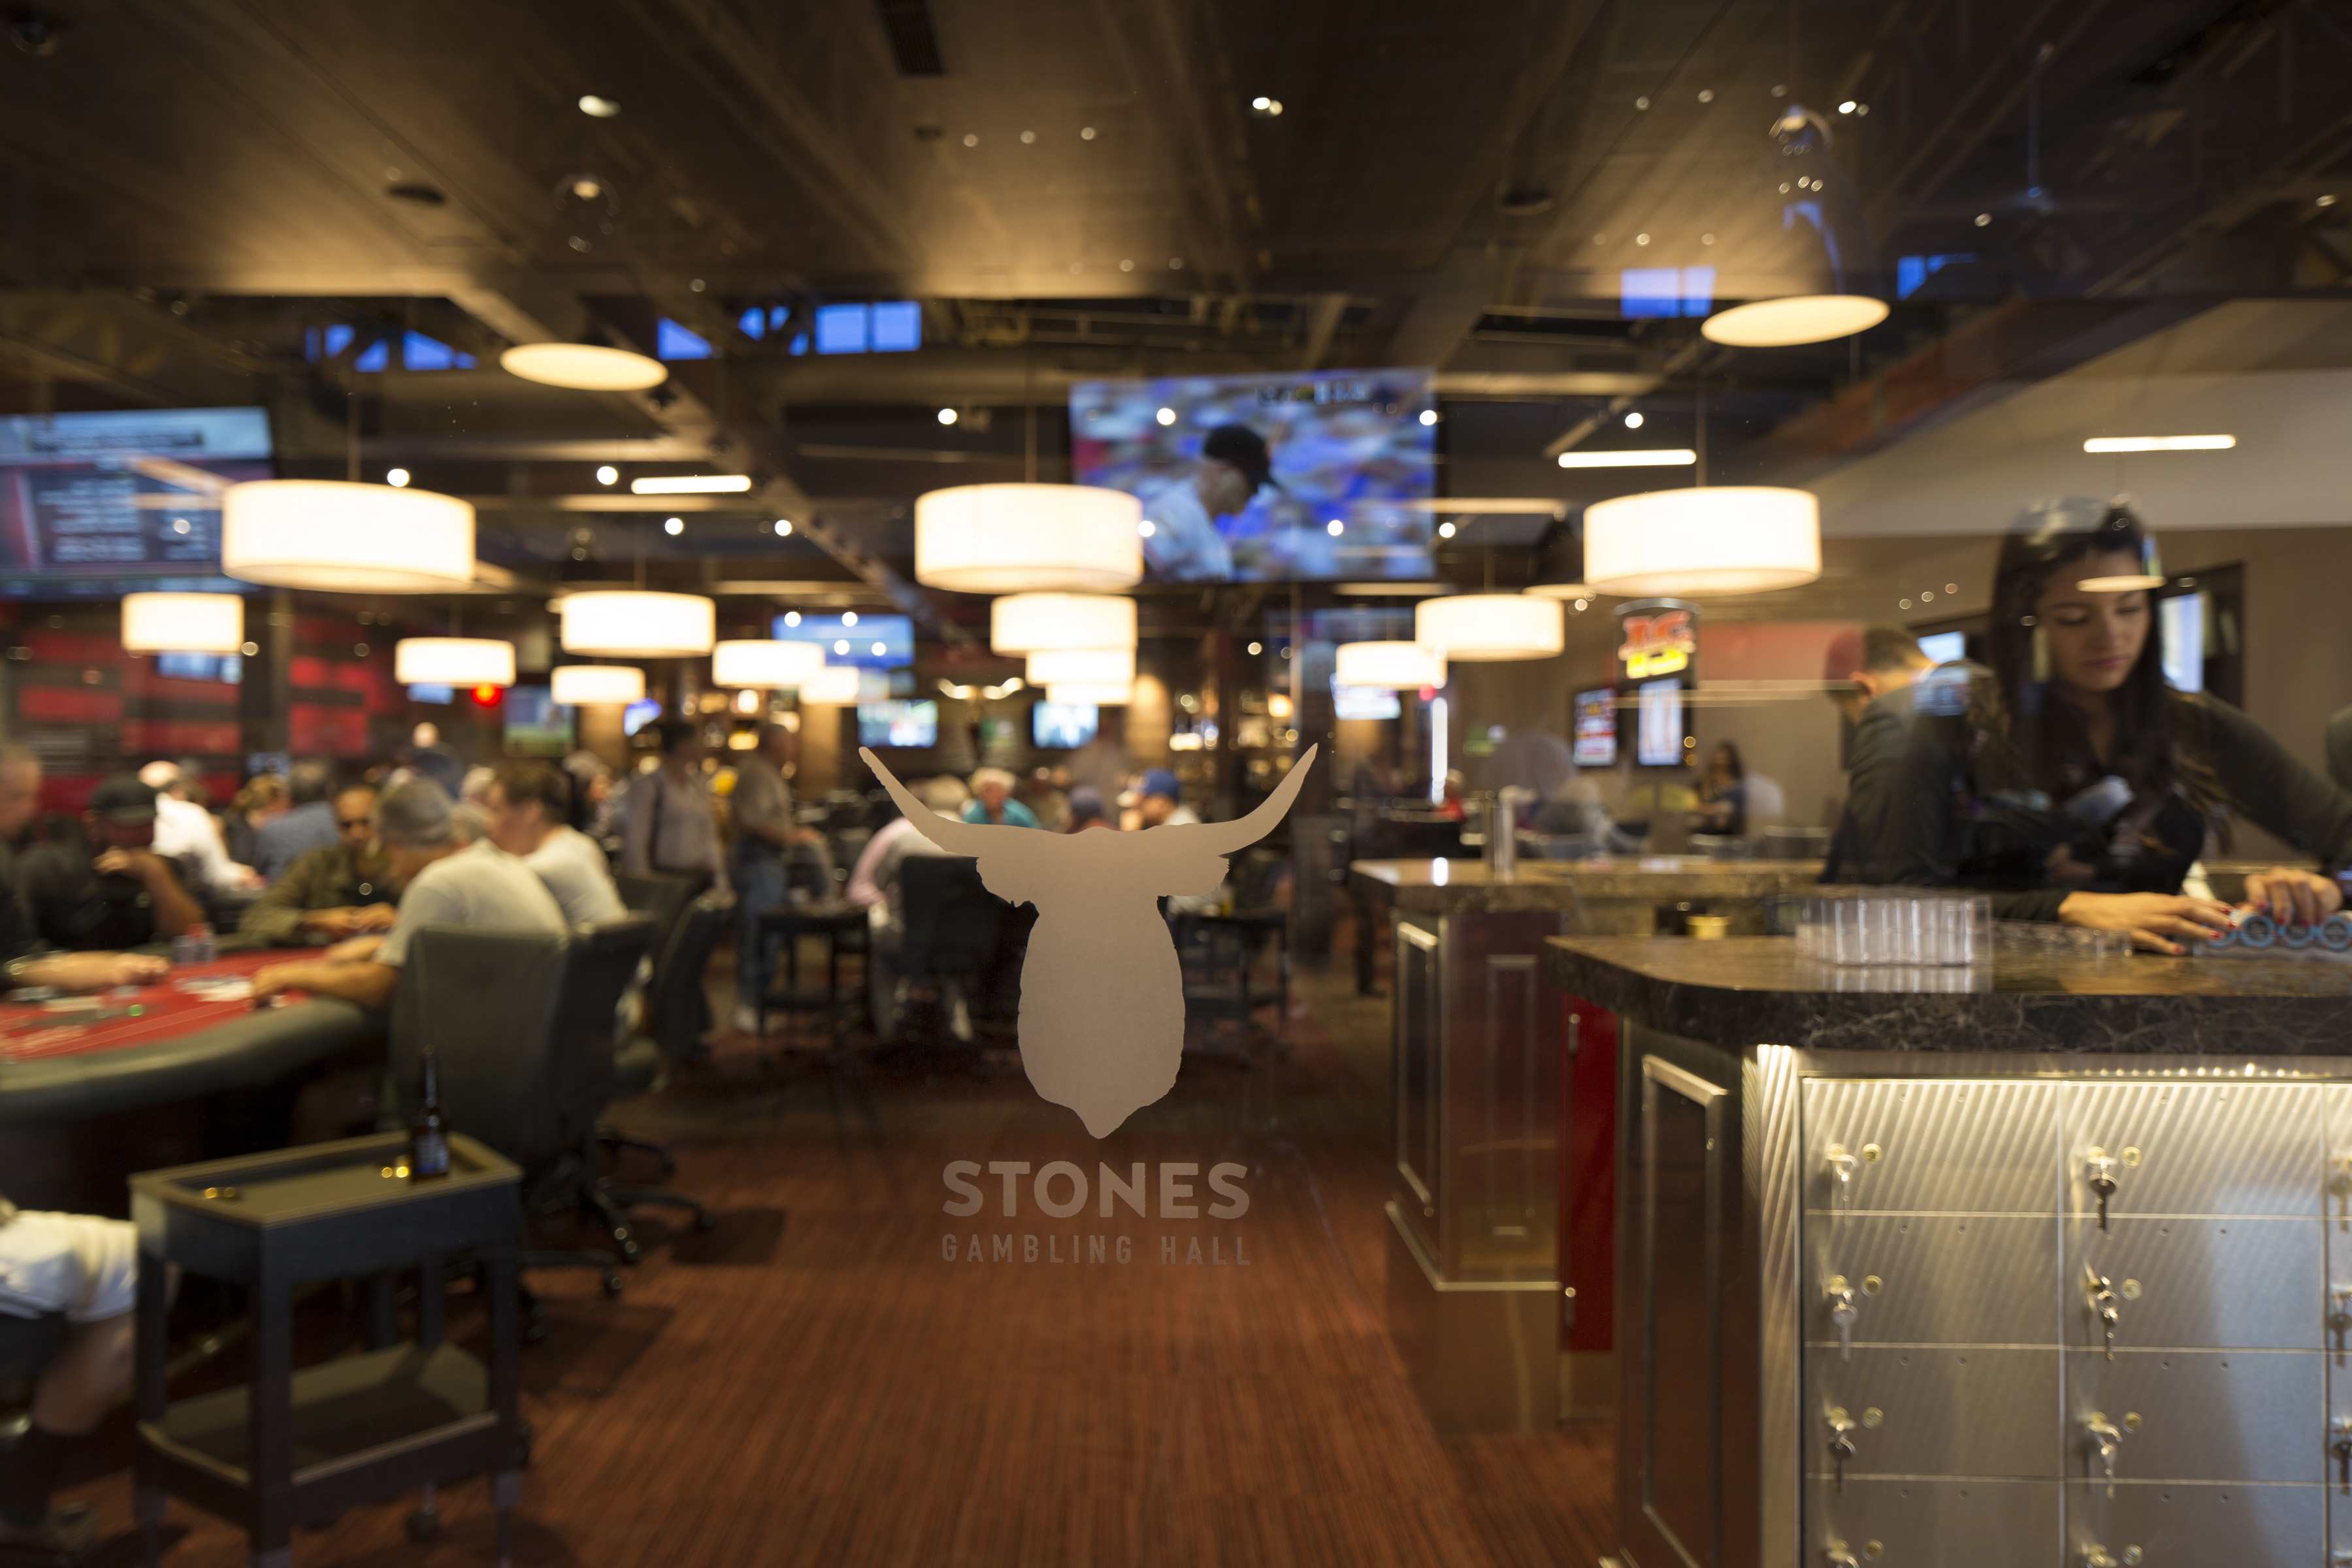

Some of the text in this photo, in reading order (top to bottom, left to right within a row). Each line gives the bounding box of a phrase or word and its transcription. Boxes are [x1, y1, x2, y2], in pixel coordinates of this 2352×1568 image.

[942, 1160, 1250, 1219] STONES
[941, 1233, 1250, 1265] GAMBLING HALL
